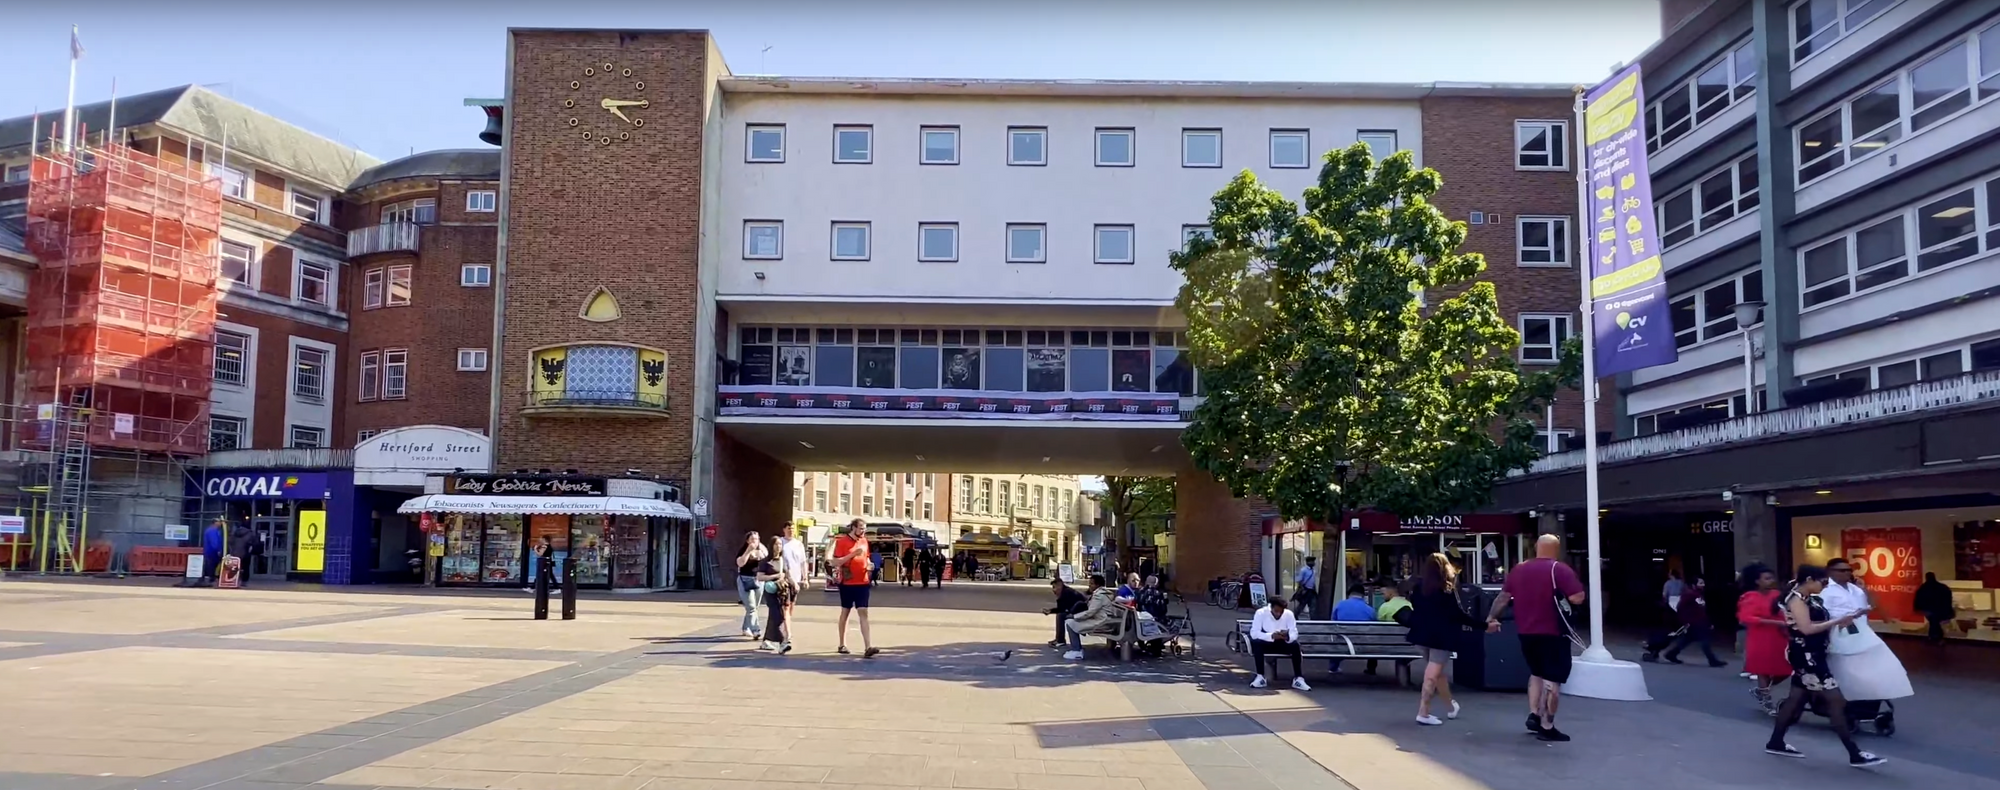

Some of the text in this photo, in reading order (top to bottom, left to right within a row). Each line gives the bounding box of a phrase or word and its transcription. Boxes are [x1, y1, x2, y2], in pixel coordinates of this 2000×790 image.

[1593, 147, 1604, 158] or
[761, 398, 778, 406] FEST
[796, 399, 814, 407] FEST
[870, 401, 888, 409] FEST
[943, 402, 960, 410] FEST
[979, 403, 997, 411] FEST
[1013, 404, 1031, 412] FEST
[1089, 404, 1105, 412] FEST
[1157, 405, 1173, 413] FEST
[380, 443, 481, 454] Hertford Street
[207, 476, 283, 496] CORAL
[453, 477, 592, 492] Lady Godiva News
[433, 500, 601, 510] Tobacconists Newsagents Confectionery
[1983, 552, 2000, 567] 5
[1897, 569, 1918, 578] OFF
